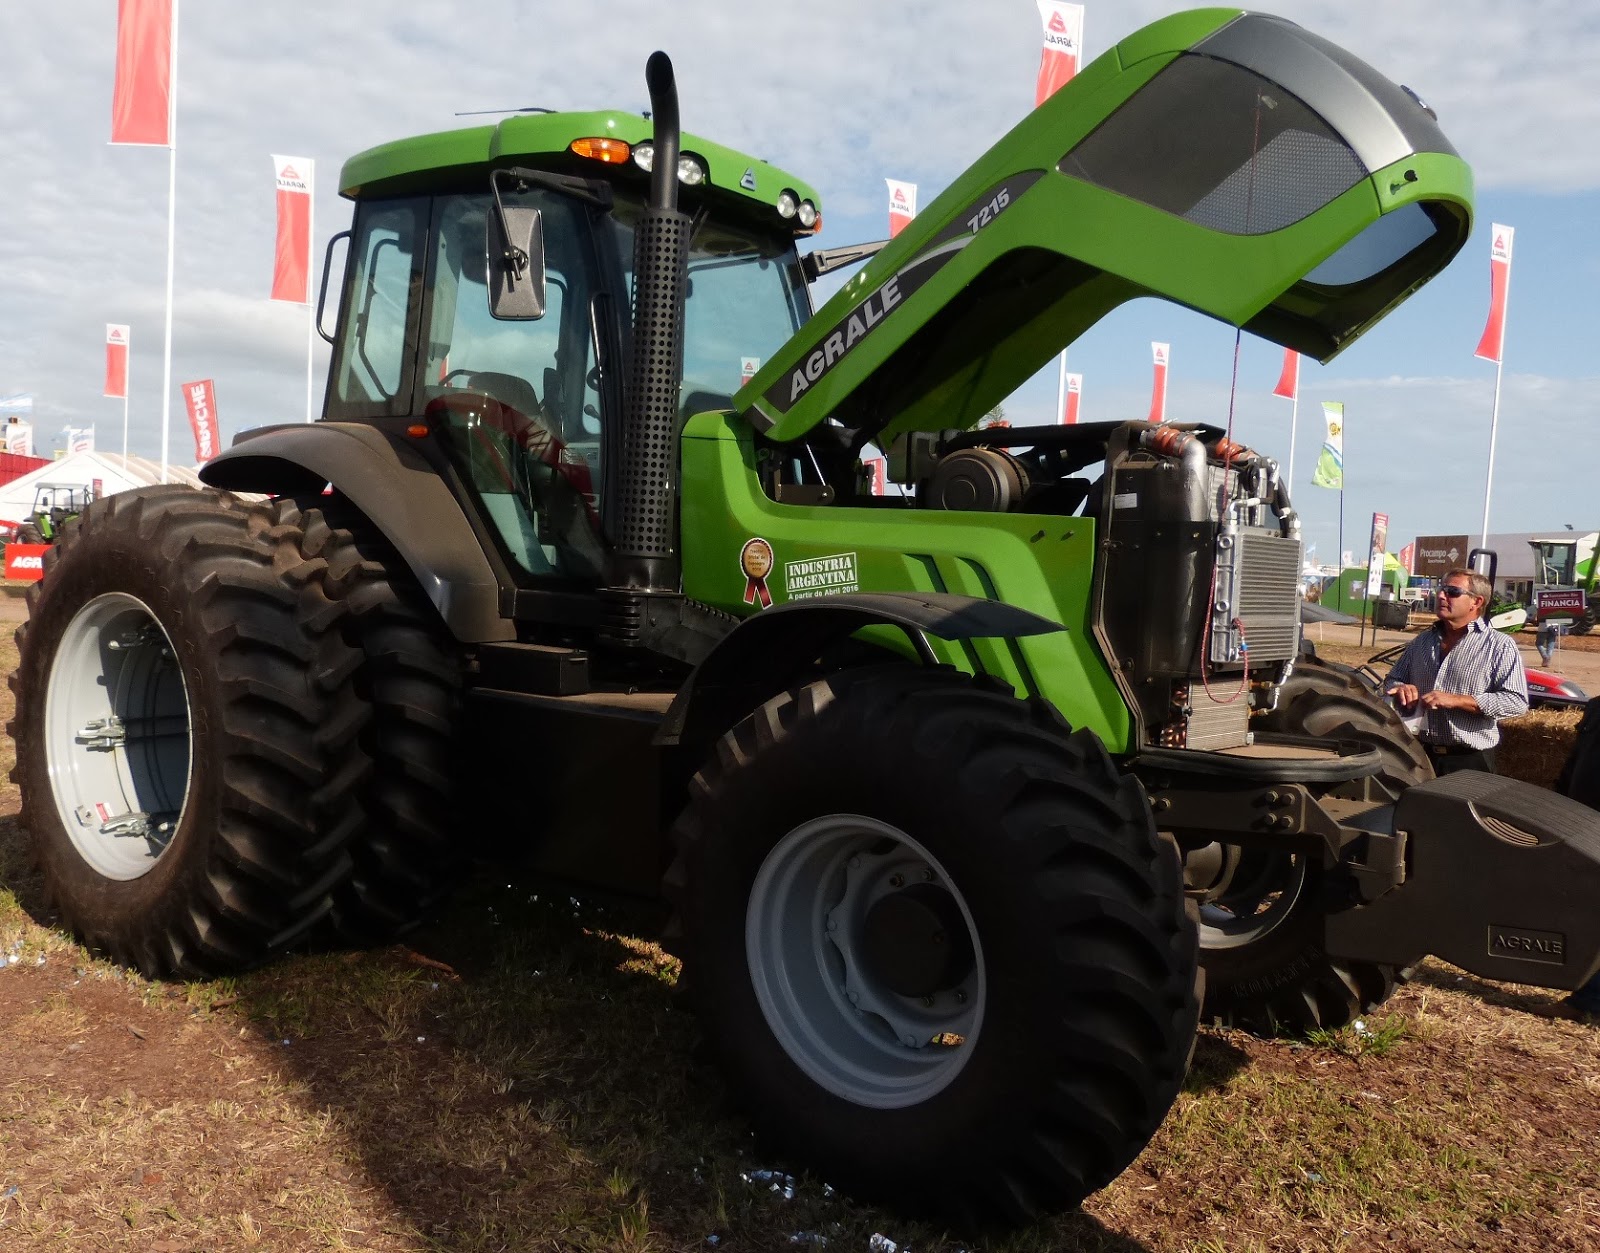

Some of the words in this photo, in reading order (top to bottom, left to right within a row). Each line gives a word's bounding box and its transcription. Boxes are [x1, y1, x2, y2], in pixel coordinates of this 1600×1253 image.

[967, 187, 1010, 234] 7215
[790, 275, 903, 402] AGRALE
[11, 556, 42, 569] AGR
[1420, 548, 1447, 559] Procampo
[789, 556, 852, 577] INDUSTRIA
[788, 569, 855, 590] ARGENTINA
[795, 591, 813, 601] partir
[824, 587, 841, 596] Abril
[842, 584, 859, 593] 2016
[1494, 934, 1562, 955] AGRALE
